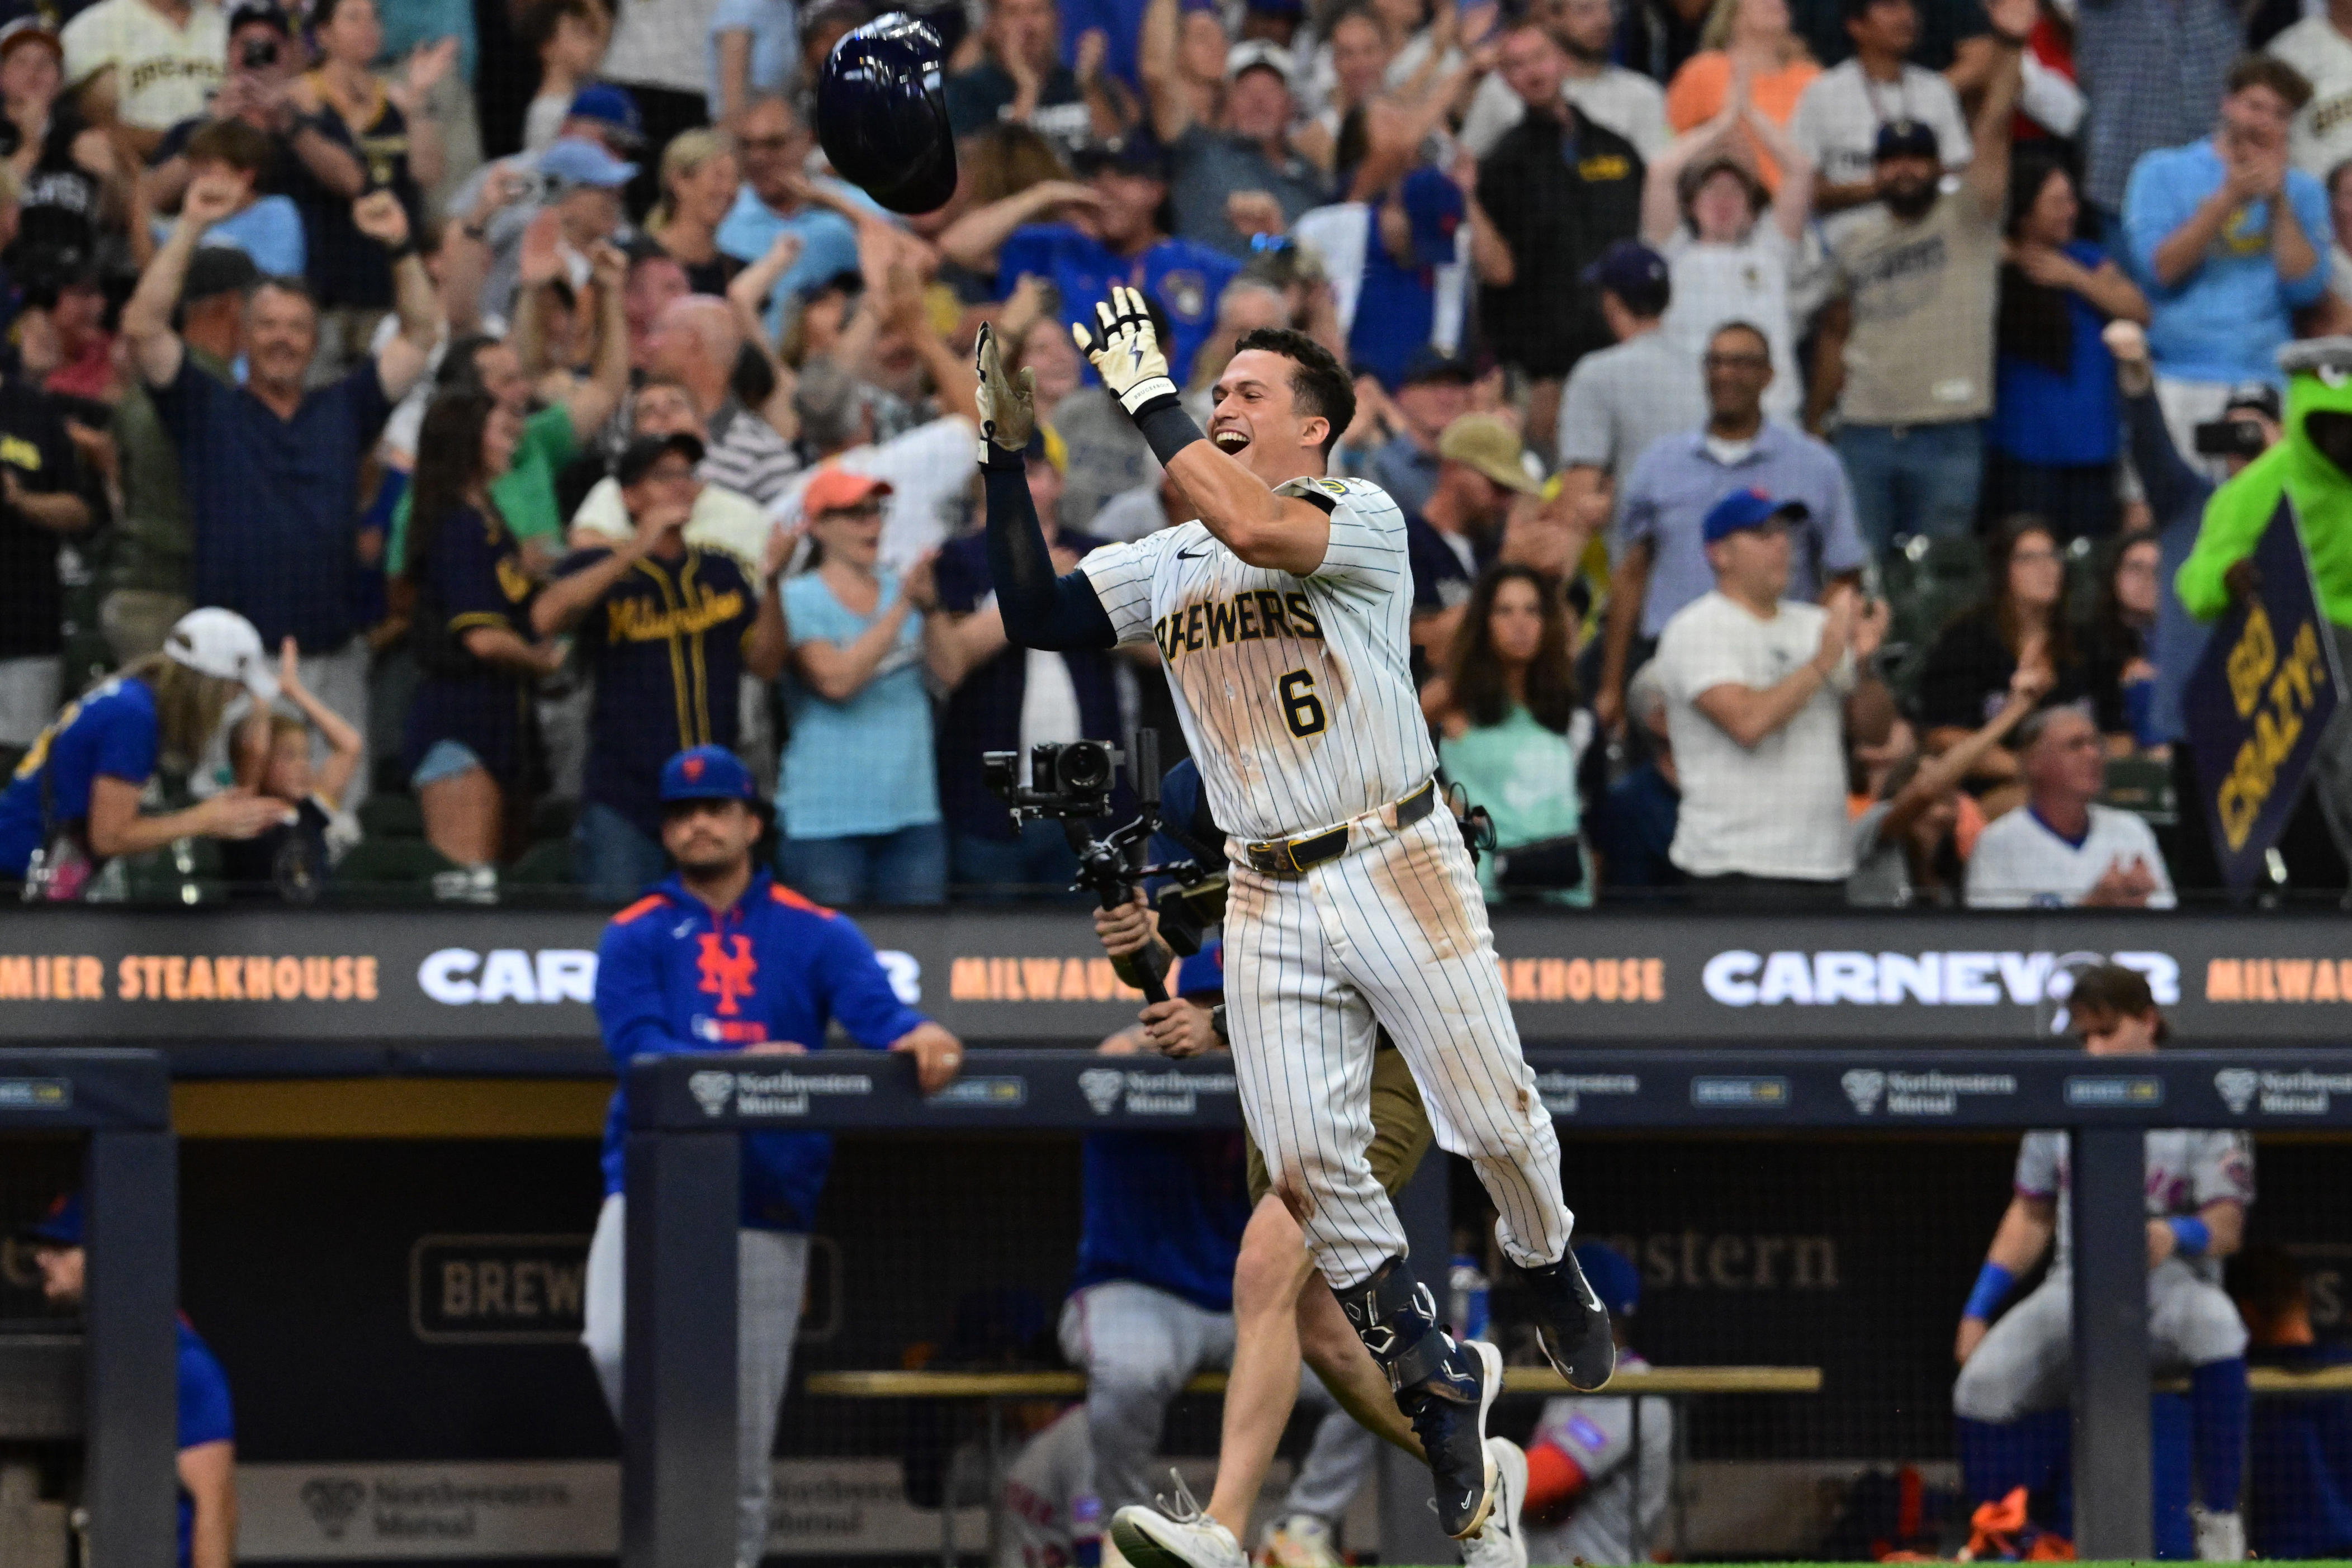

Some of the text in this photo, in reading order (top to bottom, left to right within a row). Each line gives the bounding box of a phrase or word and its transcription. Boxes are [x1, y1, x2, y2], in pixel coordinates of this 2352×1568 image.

[1154, 589, 1324, 674] BREWERS
[1278, 667, 1327, 739] 6
[118, 955, 378, 1001] STEAKHOUSE
